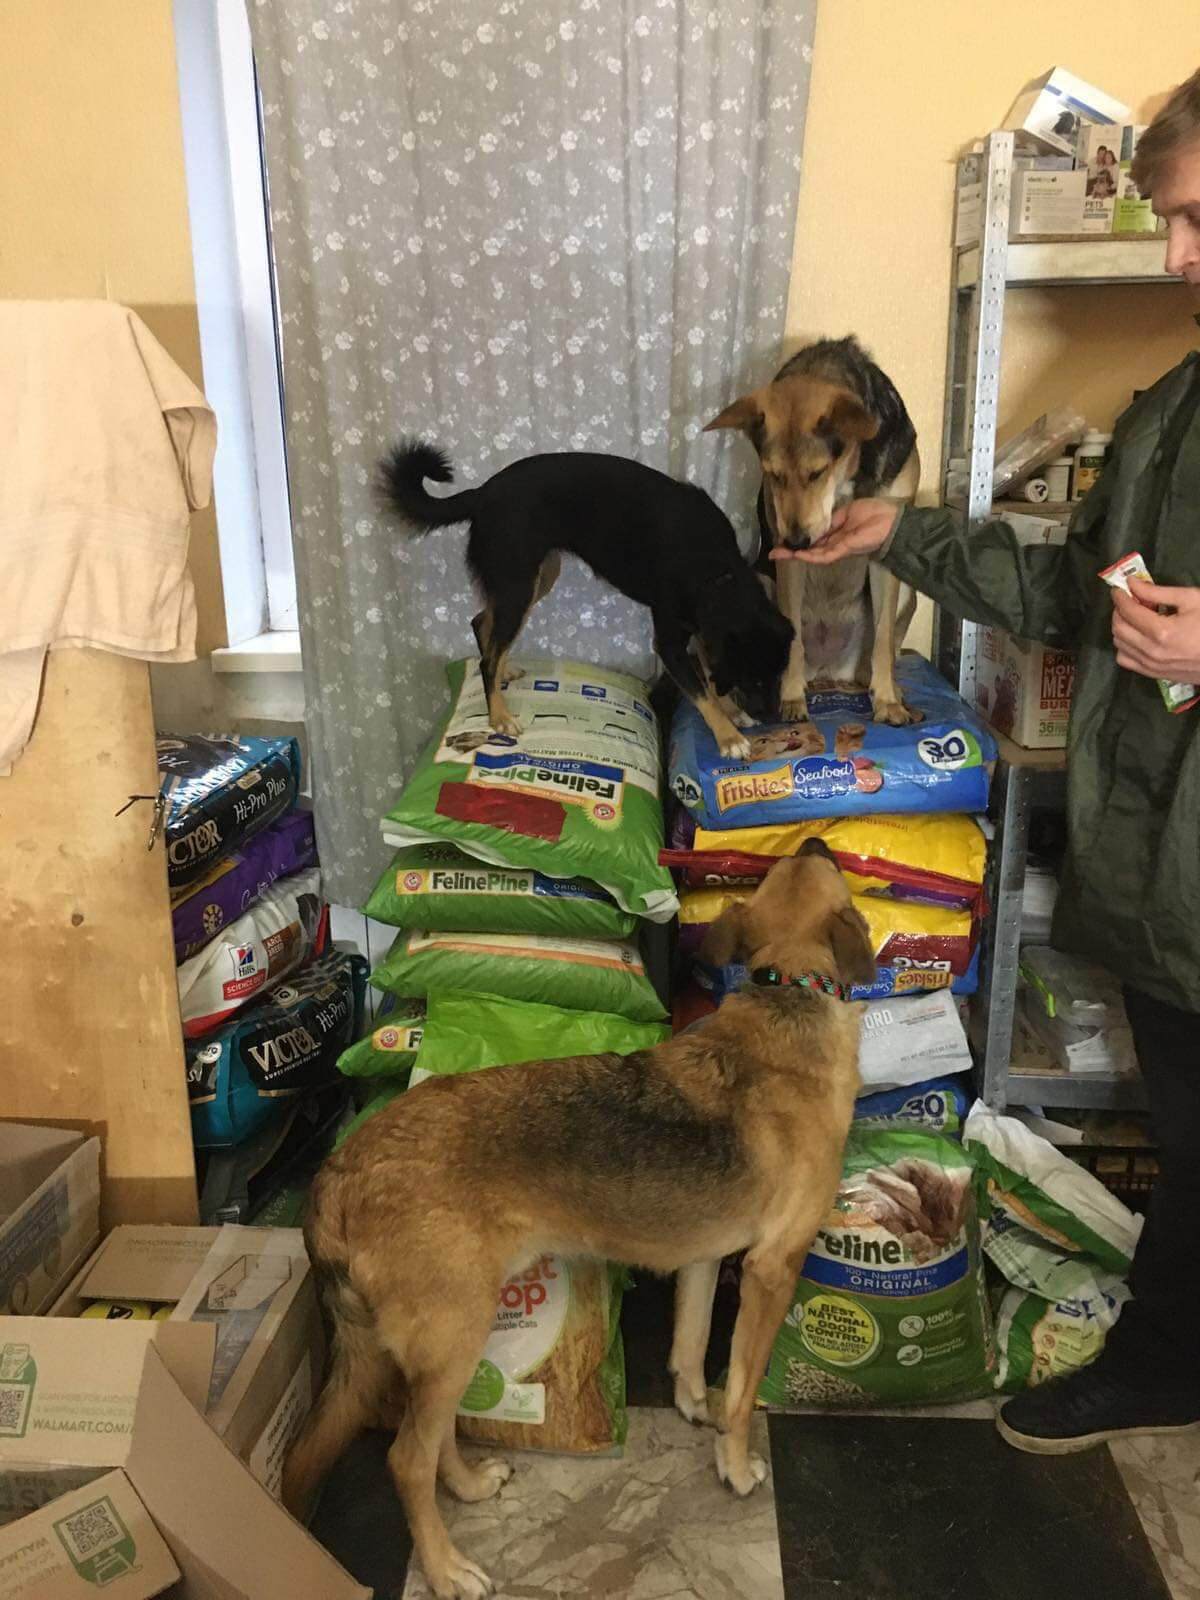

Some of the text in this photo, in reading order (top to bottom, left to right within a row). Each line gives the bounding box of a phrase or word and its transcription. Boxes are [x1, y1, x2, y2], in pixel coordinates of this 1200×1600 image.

[923, 737, 966, 758] 30
[478, 767, 616, 800] FelinePine
[722, 776, 791, 804] Friskies
[795, 765, 852, 785] Seafood
[233, 777, 286, 824] Hi-Pro Plus
[170, 820, 223, 865] CTOR
[432, 871, 529, 892] FelinePine
[864, 1009, 893, 1029] ORD
[248, 1026, 322, 1072] VICTOR
[902, 1094, 945, 1118] 30
[850, 1275, 931, 1290] ORIGINAL
[871, 1270, 913, 1281] Natural
[500, 1283, 547, 1316] op
[497, 1311, 524, 1321] Litter
[807, 1307, 869, 1328] NATURAL
[821, 1304, 856, 1317] BEST
[518, 1320, 538, 1329] Cats
[805, 1324, 869, 1344] CONTROL
[818, 1320, 857, 1334] ODOR
